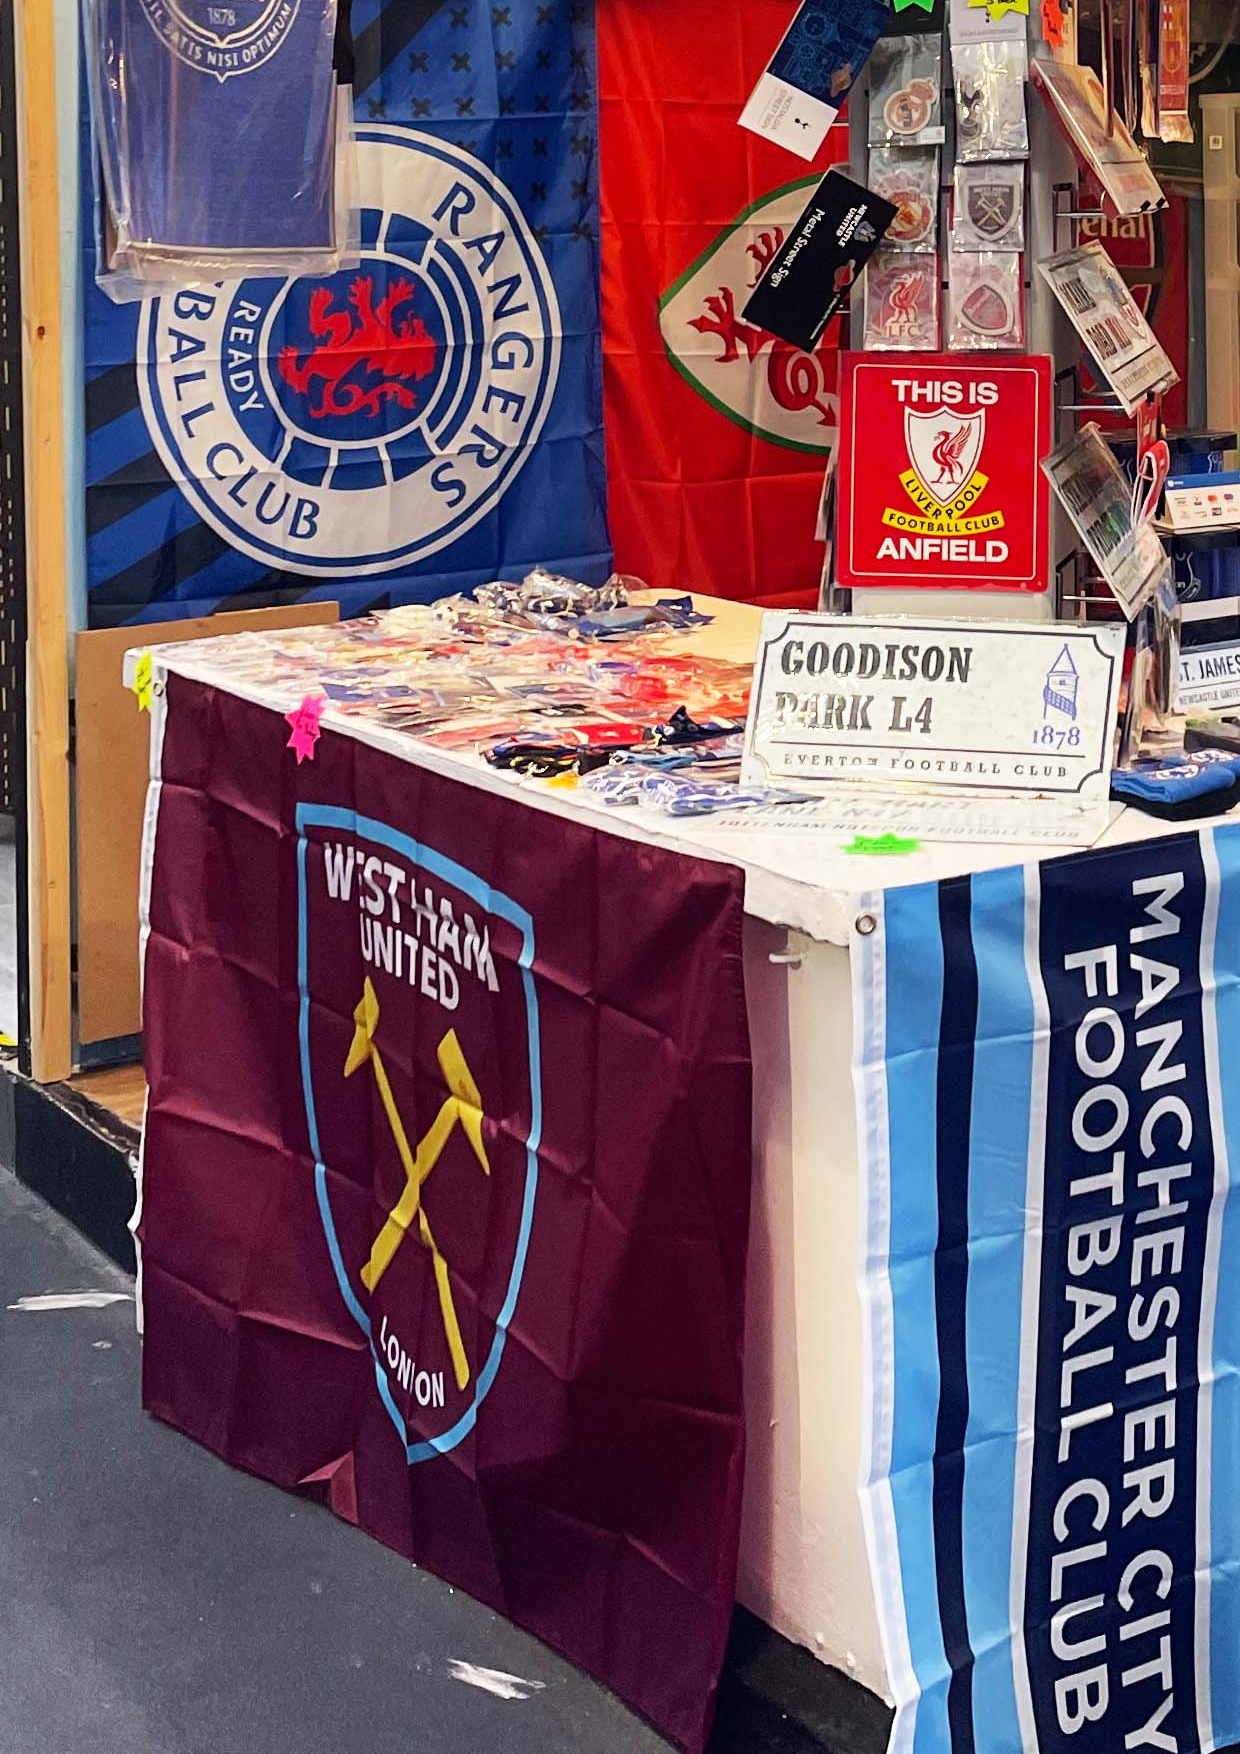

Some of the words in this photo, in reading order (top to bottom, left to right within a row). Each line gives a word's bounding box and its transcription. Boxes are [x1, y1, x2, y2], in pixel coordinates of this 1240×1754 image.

[163, 22, 203, 60] SATIS
[207, 51, 239, 67] NISI
[241, 3, 292, 63] OPTIMUM
[207, 7, 237, 26] 1878
[804, 208, 826, 238] Metal
[836, 207, 858, 238] UNITED
[838, 203, 868, 247] NEWCASTLE
[783, 234, 809, 267] Street
[770, 265, 791, 288] Sign
[226, 299, 266, 413] READY
[431, 180, 534, 509] RANGERS
[168, 288, 225, 439] BALL
[206, 441, 321, 540] CLUB
[891, 379, 964, 405] THIS
[969, 382, 999, 406] IS
[905, 477, 982, 520] LIVERPOOL
[888, 513, 961, 533] FOOTBALL
[965, 515, 1000, 531] CLUB
[876, 537, 1009, 563] ANFIELD
[780, 640, 973, 683] GOODISON
[775, 691, 875, 731] PARK
[888, 696, 934, 734] L4
[1179, 688, 1220, 706] NEWCASTLE
[1031, 727, 1081, 750] 1878
[783, 753, 879, 768] EVERTON
[890, 756, 1001, 775] FOOTBALL
[1014, 763, 1069, 778] CLUB
[410, 878, 500, 992] HAM
[360, 912, 460, 1011] UNITED
[1056, 942, 1130, 1467] FOOTBALL
[1118, 868, 1196, 1531] MANCHESTER
[1045, 1481, 1113, 1738] CLUB
[1115, 1569, 1180, 1754] CITY
